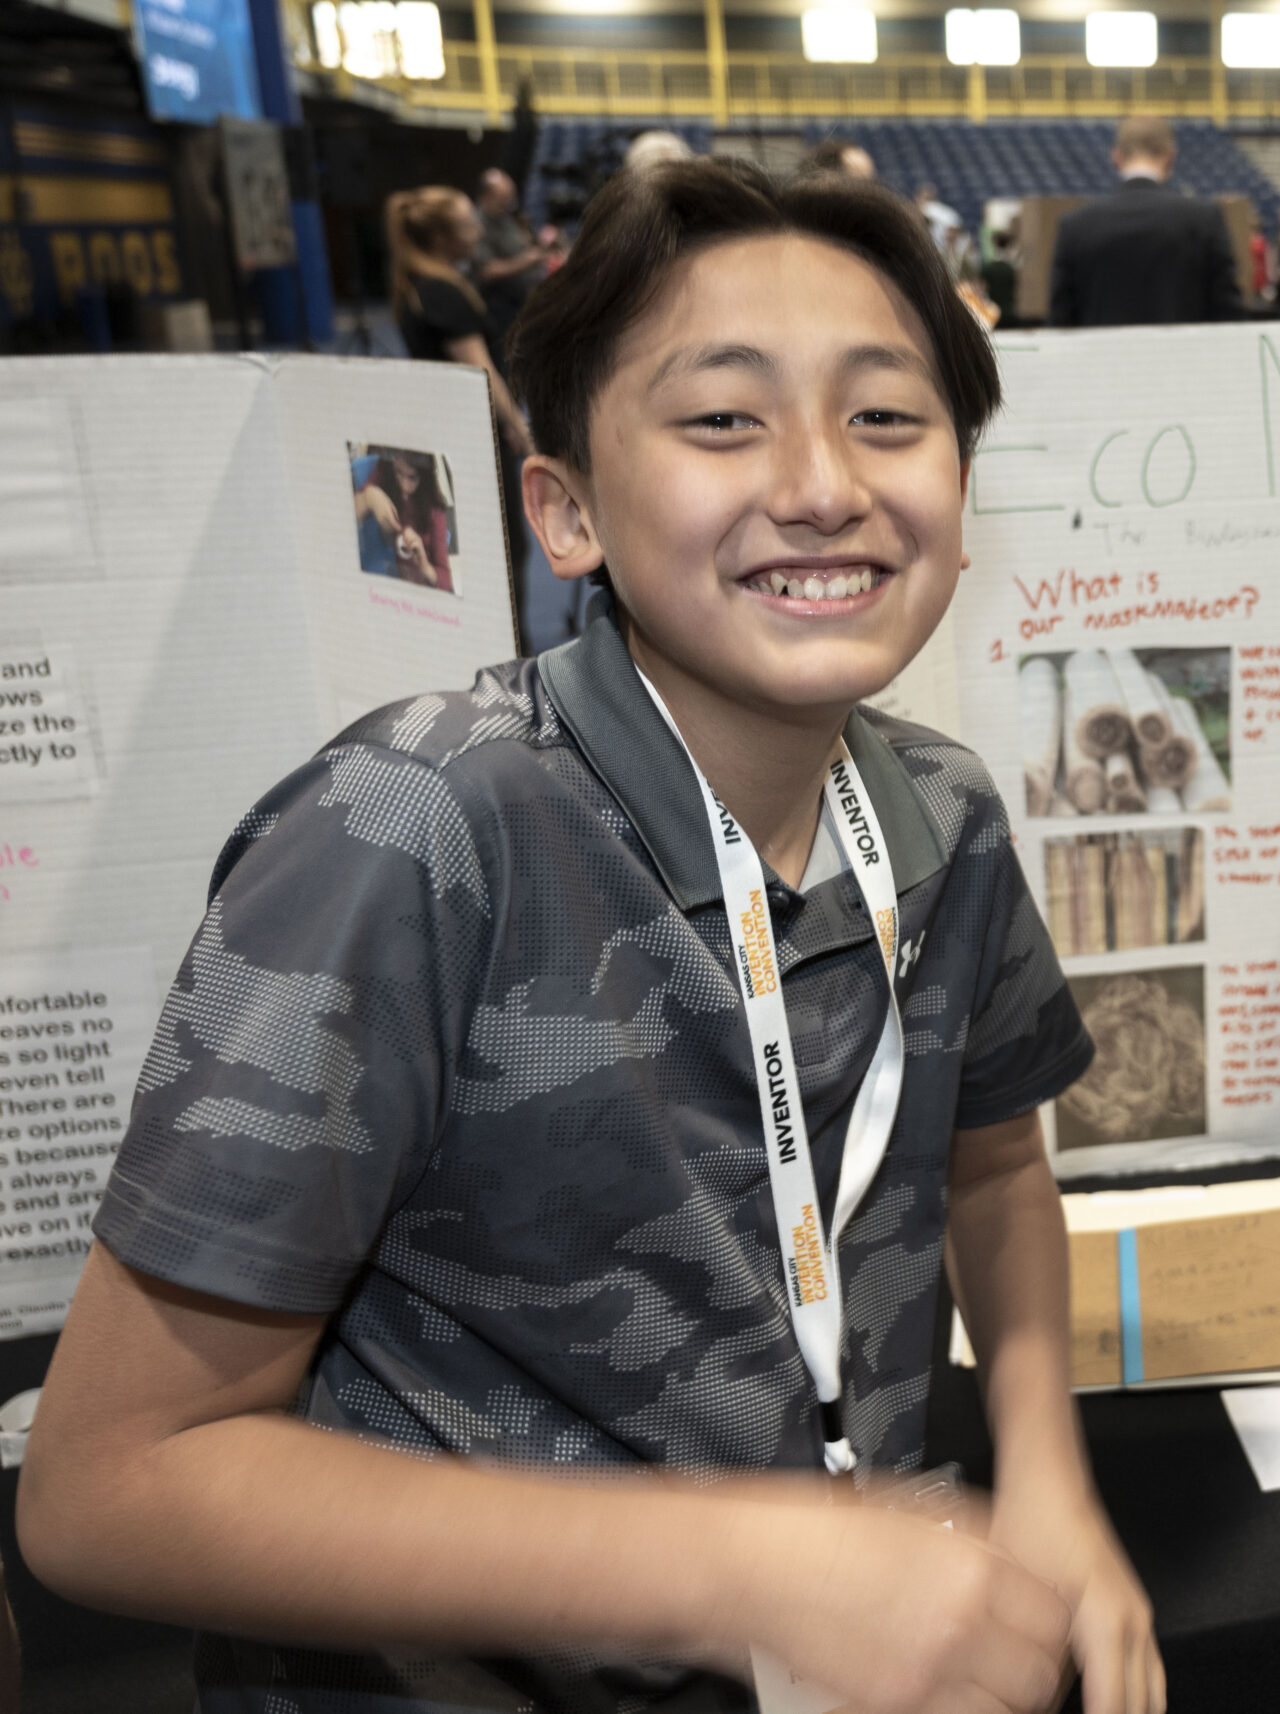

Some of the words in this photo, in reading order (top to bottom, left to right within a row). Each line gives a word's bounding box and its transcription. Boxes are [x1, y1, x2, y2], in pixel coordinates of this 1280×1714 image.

[970, 345, 1198, 515] Eco
[1015, 570, 1122, 611] What
[1137, 572, 1159, 594] is
[1019, 615, 1064, 639] our
[2, 657, 52, 680] and
[32, 714, 76, 733] the
[49, 742, 76, 760] to
[830, 759, 880, 867] INVENTOR
[738, 944, 749, 962] CITY
[740, 912, 766, 996] INVENTION
[749, 889, 777, 994] CONVENTION
[743, 961, 755, 999] KANSAS
[81, 1017, 114, 1034] no
[18, 1048, 48, 1066] so
[54, 1041, 111, 1065] light
[0, 1072, 60, 1092] even
[67, 1067, 105, 1086] tell
[74, 1091, 117, 1110] are
[764, 1040, 797, 1165] INVENTOR
[28, 1116, 122, 1141] options
[16, 1141, 121, 1166] because
[10, 1168, 97, 1190] always
[14, 1191, 60, 1211] and
[40, 1217, 70, 1233] on
[801, 1203, 827, 1301] CONVENTION
[791, 1226, 815, 1304] INVENTION
